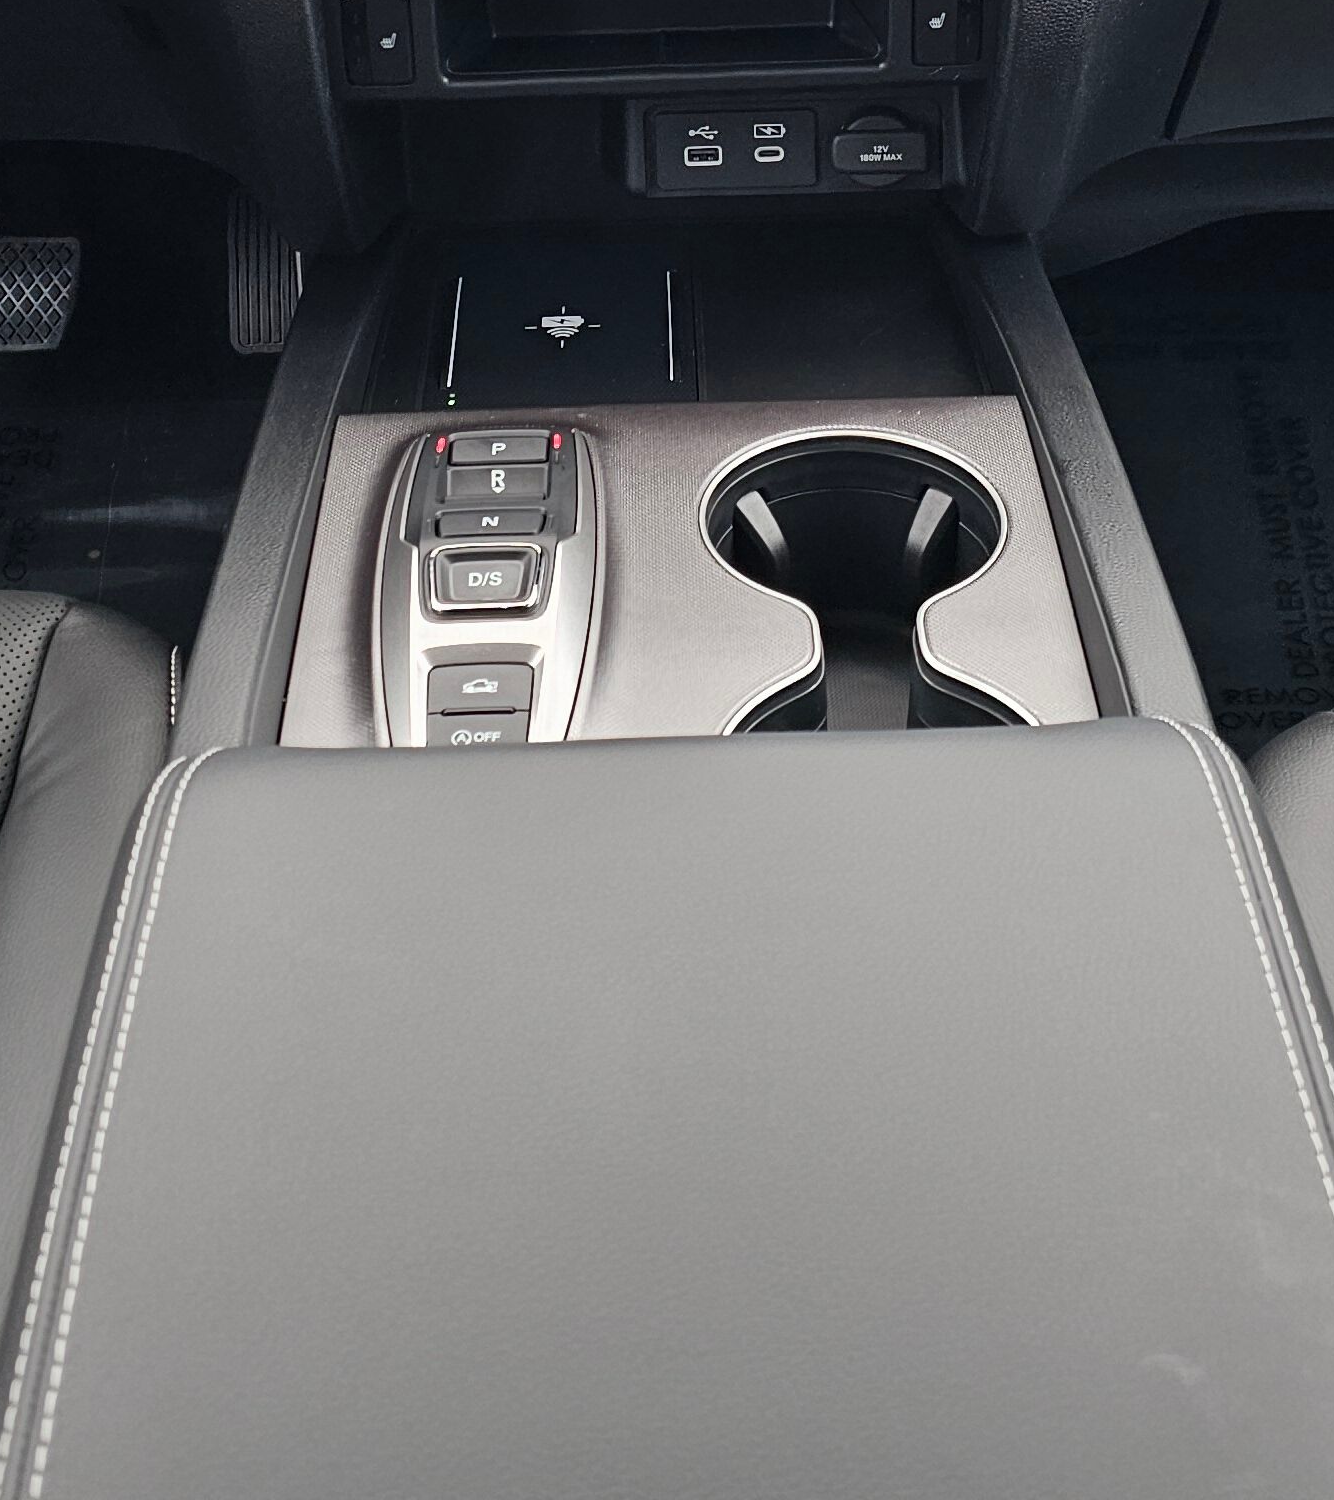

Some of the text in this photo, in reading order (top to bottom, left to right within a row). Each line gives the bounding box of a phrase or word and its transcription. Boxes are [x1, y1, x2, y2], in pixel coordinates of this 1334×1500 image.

[873, 145, 889, 153] 12V
[883, 153, 903, 161] MAX
[491, 443, 507, 456] P
[491, 469, 505, 489] R
[481, 516, 500, 527] N
[468, 571, 503, 587] D/S
[473, 731, 502, 742] OFF
